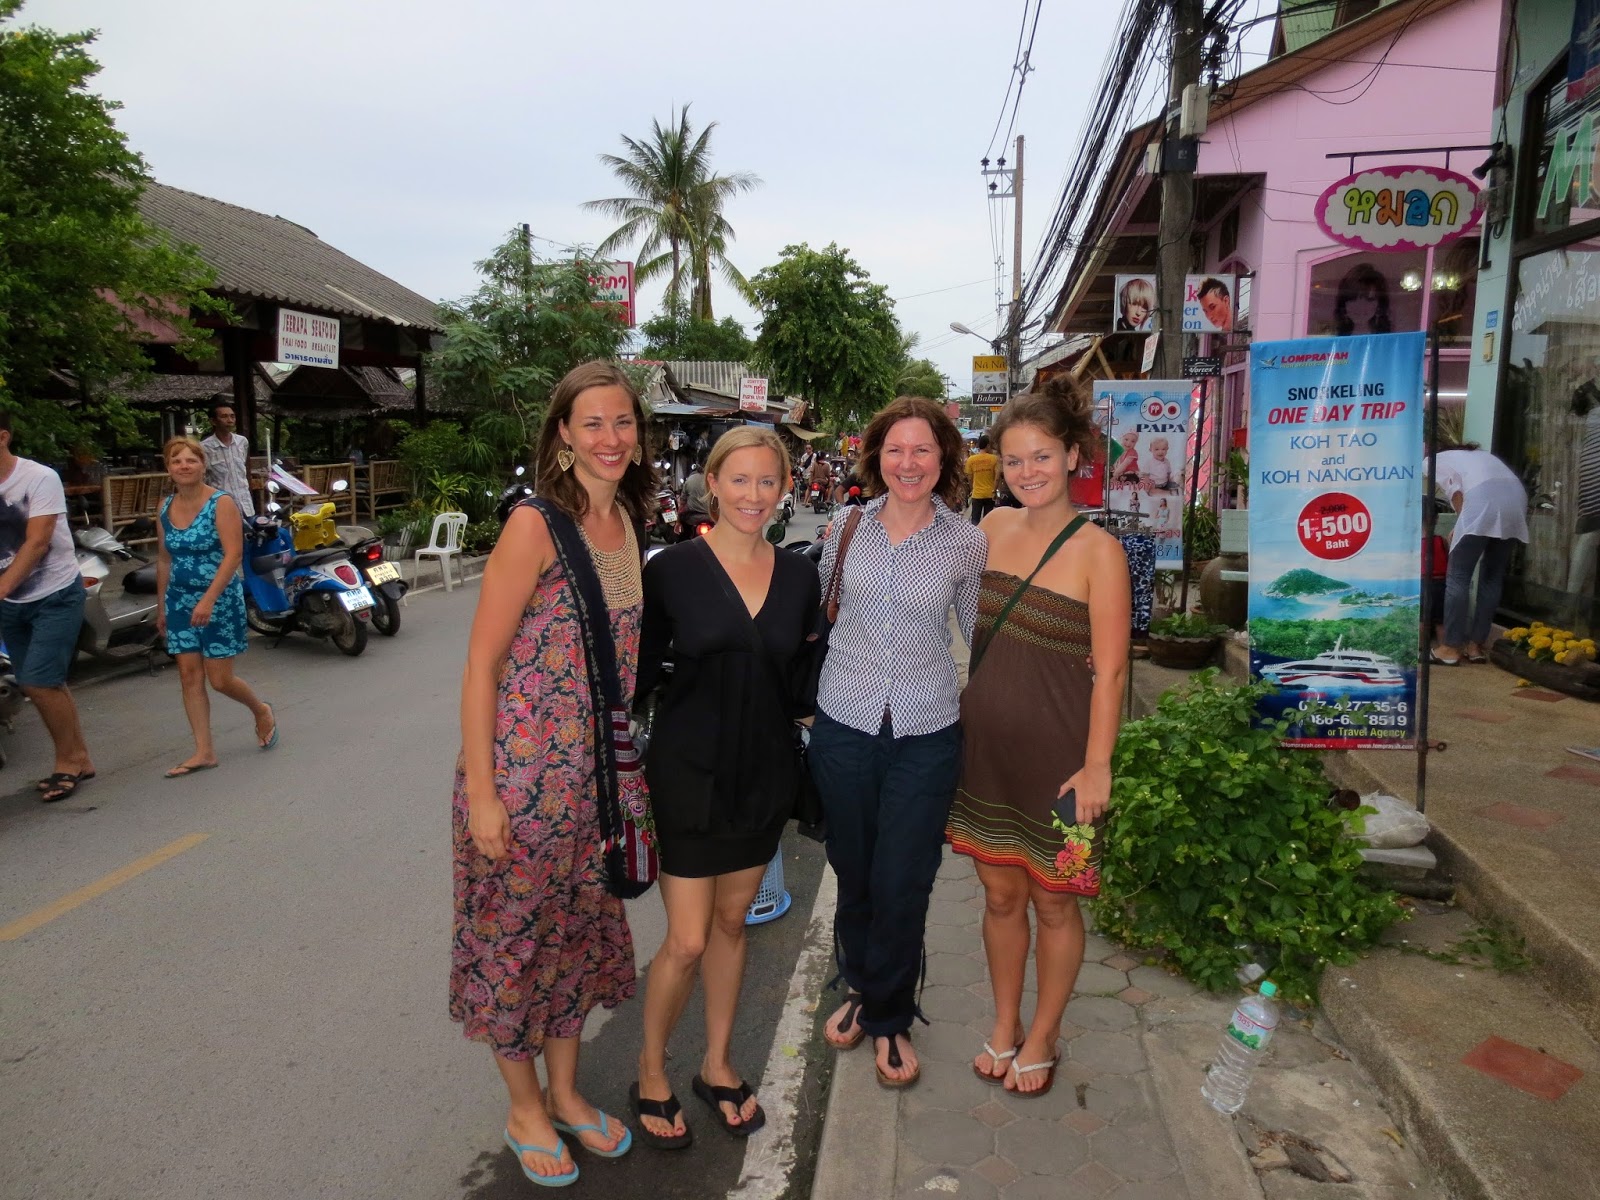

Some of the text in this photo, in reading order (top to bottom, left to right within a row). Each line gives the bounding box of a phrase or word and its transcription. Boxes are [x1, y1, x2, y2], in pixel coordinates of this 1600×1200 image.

[1343, 187, 1459, 227] หมอก
[312, 319, 337, 340] SEAFOOD
[282, 337, 293, 347] THAI
[295, 339, 308, 349] FOOD
[976, 394, 1004, 404] Bakery
[1268, 402, 1406, 425] ONE DAY TRIP
[1136, 424, 1185, 433] PAPA
[1290, 433, 1378, 450] KOH TAO
[1321, 454, 1345, 466] and
[1262, 466, 1415, 485] KOH NANGYUAN
[1300, 512, 1368, 542] 1,500
[1325, 539, 1350, 550] Baht
[1338, 727, 1367, 737] Travel
[1370, 728, 1406, 738] Agency
